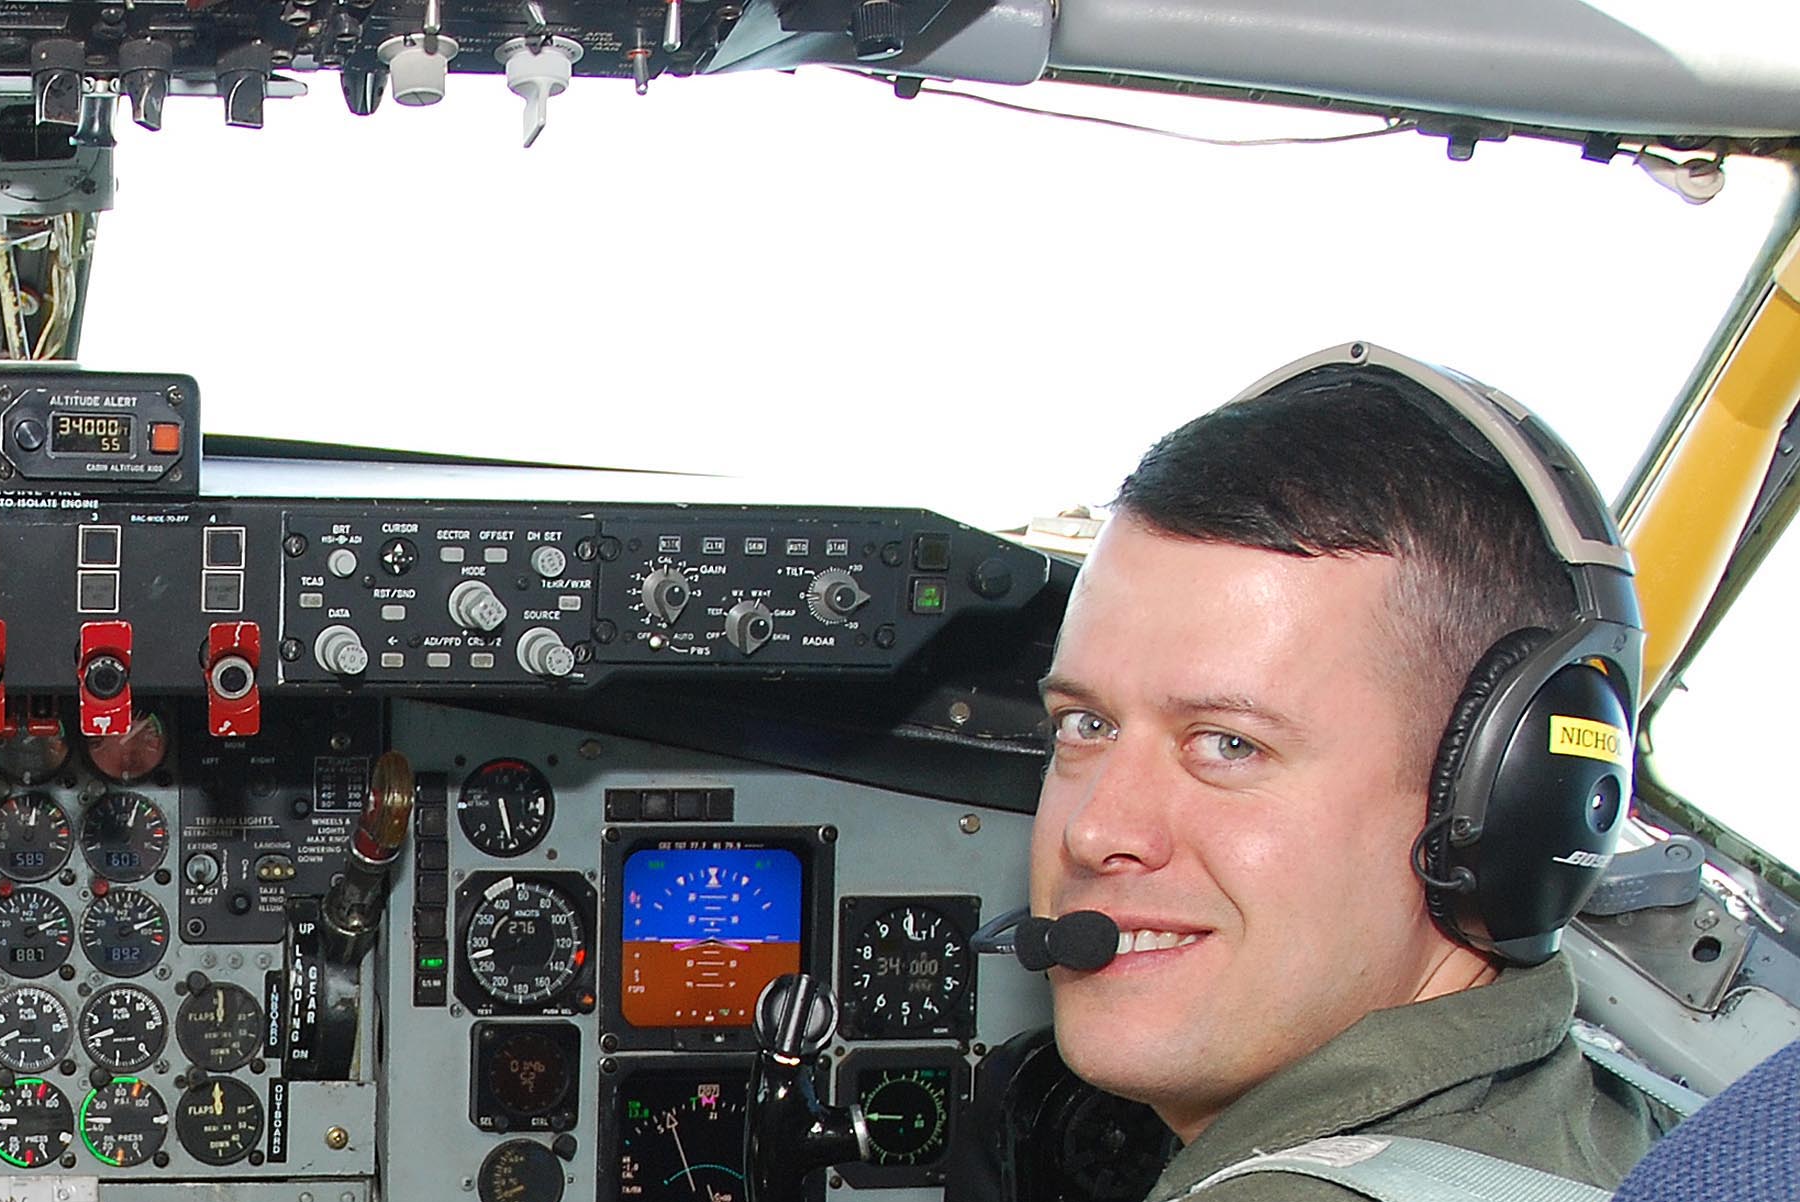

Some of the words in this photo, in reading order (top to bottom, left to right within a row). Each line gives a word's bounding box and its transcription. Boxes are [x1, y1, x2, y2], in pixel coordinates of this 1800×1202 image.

[50, 396, 101, 408] ALTITUDE
[104, 396, 137, 408] ALERT
[59, 417, 118, 435] 34000
[86, 464, 107, 472] CABIN
[110, 464, 144, 473] ALTITUDE
[0, 498, 14, 508] TO
[17, 499, 59, 509] ISOLATE
[61, 499, 99, 510] ENGINE
[333, 525, 350, 535] BRT
[382, 524, 418, 534] CURSOR
[437, 530, 470, 540] SECTOR
[479, 531, 514, 541] OFFSET
[527, 531, 541, 541] DH
[544, 531, 562, 541] SET
[462, 567, 486, 576] MODE
[700, 565, 726, 575] GAIN
[786, 567, 804, 577] TILT
[301, 577, 324, 586] TCAS
[328, 608, 350, 618] DATA
[524, 611, 560, 620] SOURCE
[673, 632, 694, 640] AUTO
[802, 636, 835, 647] RADAR
[424, 637, 461, 647] ADI/PFD
[1560, 726, 1622, 755] NICHO
[239, 816, 274, 825] LIGHTS
[312, 818, 342, 826] WHEELS
[318, 826, 345, 834] LIGHTS
[254, 841, 291, 849] LANDING
[298, 846, 341, 854] LOWERING
[494, 899, 510, 910] 400
[514, 909, 540, 918] KNOTS
[478, 914, 494, 925] 350
[551, 914, 567, 925] 100
[299, 922, 315, 936] UP
[508, 921, 535, 934] 276
[879, 924, 889, 938] 9
[472, 936, 488, 947] 300
[556, 936, 572, 947] 120
[862, 946, 872, 960] 8
[944, 943, 954, 957] 2
[479, 961, 495, 972] 250
[550, 961, 565, 972] 140
[876, 957, 900, 975] 34
[908, 958, 939, 975] 000
[492, 976, 508, 987] 200
[535, 977, 550, 987] 160
[944, 977, 953, 991] 3
[289, 944, 303, 1043] LANDING
[307, 966, 317, 1024] GEAR
[513, 984, 529, 995] 180
[877, 994, 886, 1008] 6
[901, 1002, 910, 1015] 5
[923, 997, 932, 1011] 4
[189, 1012, 215, 1021] FLAPS
[268, 984, 279, 1046] INBOARD
[292, 1049, 309, 1060] DN
[188, 1106, 215, 1115] FLAPS
[274, 1084, 283, 1155] OUTBOARD
[119, 1134, 143, 1142] PRESS
